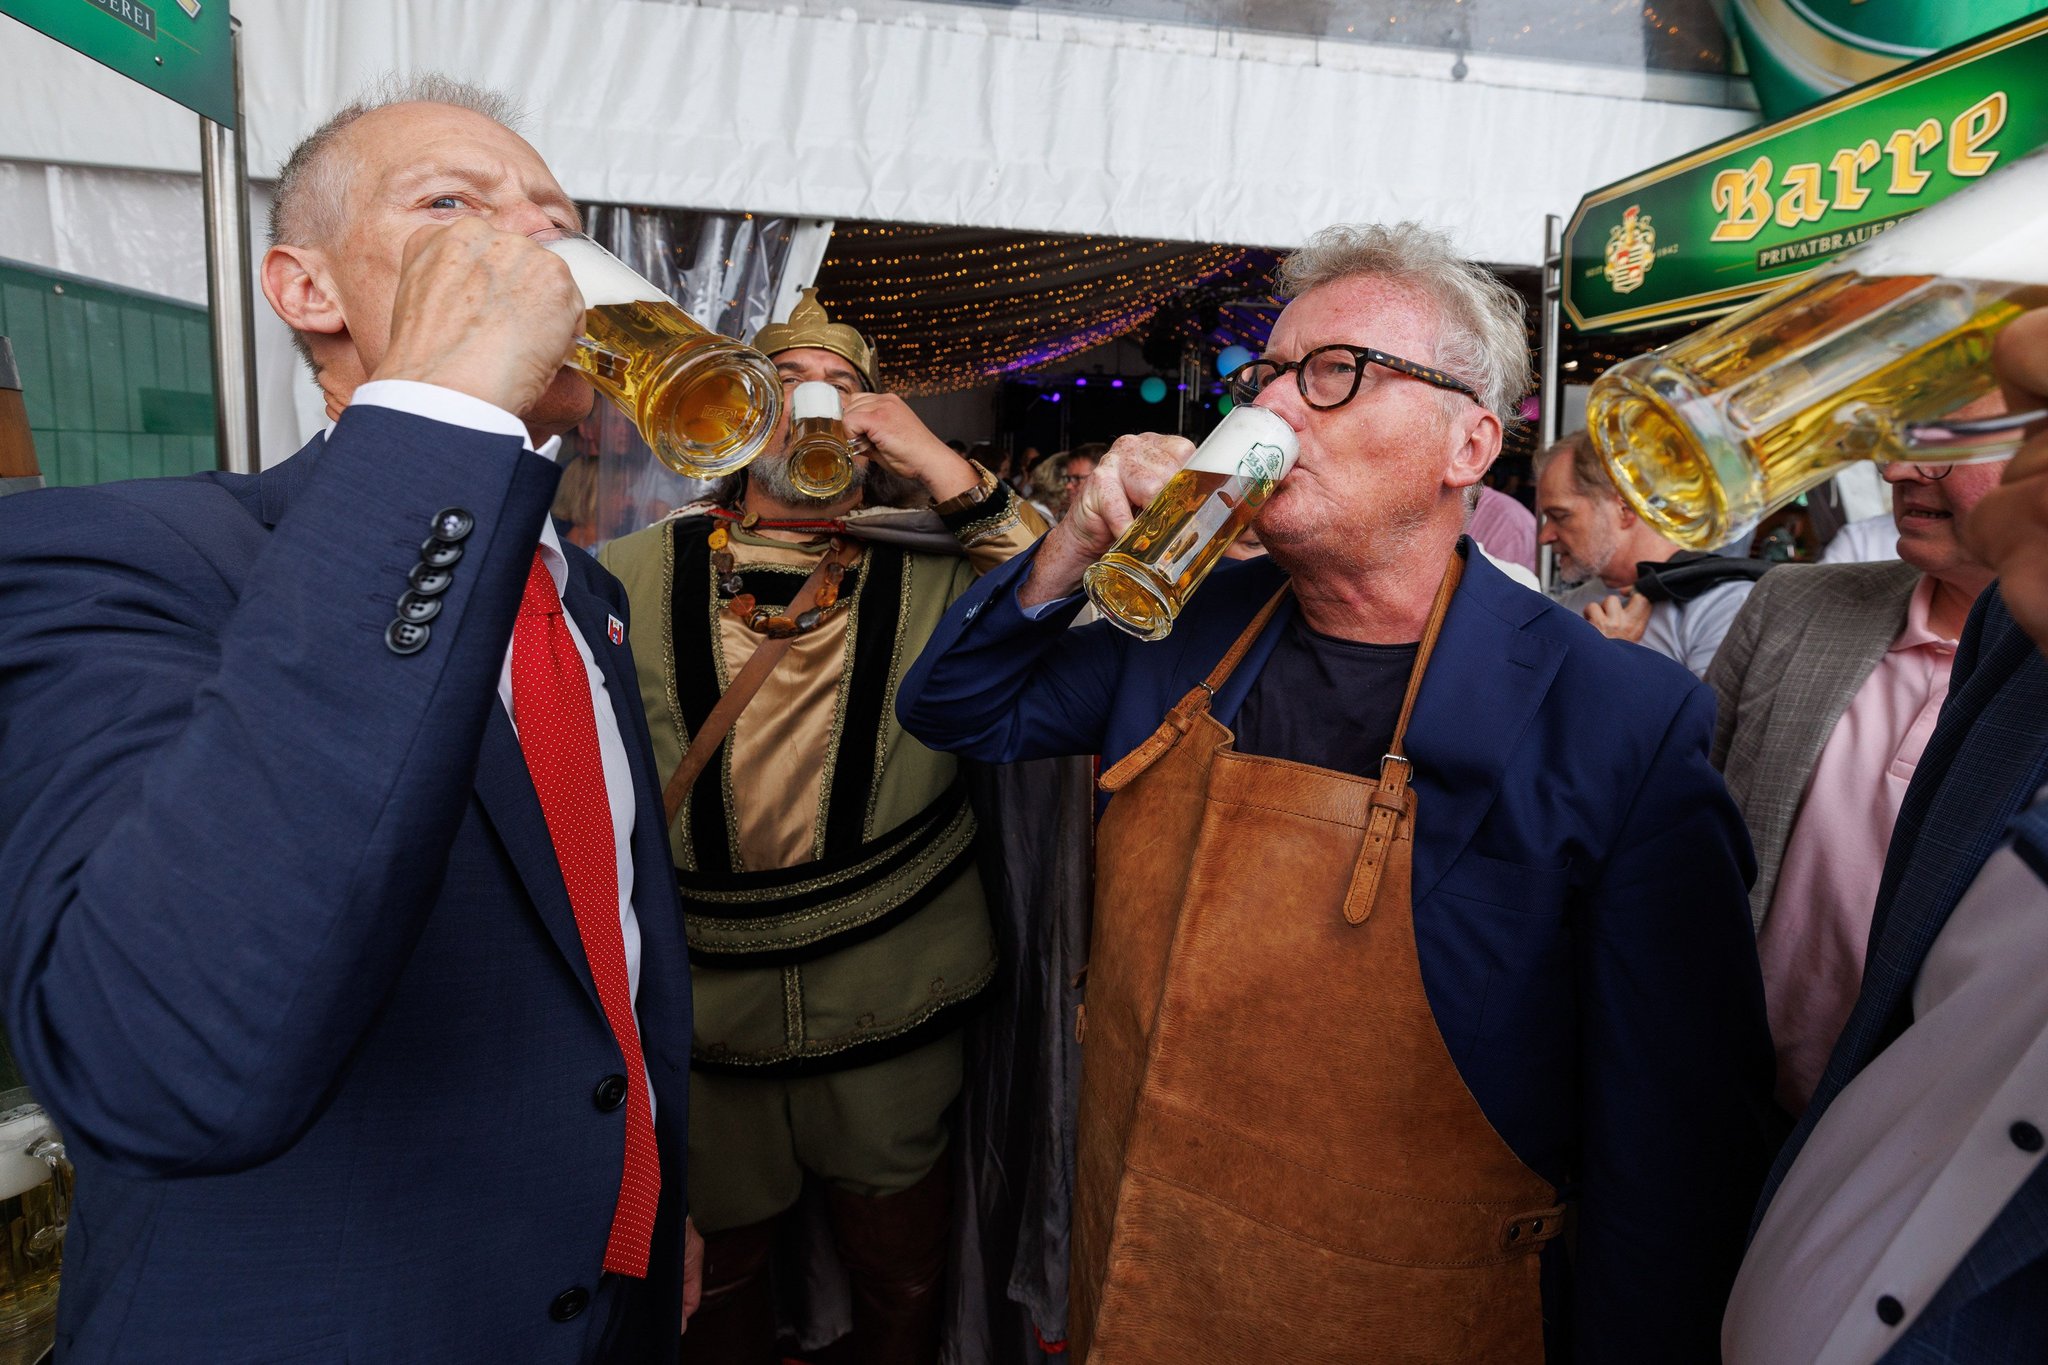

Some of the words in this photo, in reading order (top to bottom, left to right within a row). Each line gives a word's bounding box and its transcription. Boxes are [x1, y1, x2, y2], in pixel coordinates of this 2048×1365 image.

[98, 0, 150, 31] EREI
[1709, 90, 2008, 242] Barre
[1760, 215, 1911, 268] PRIVATBRAUE
